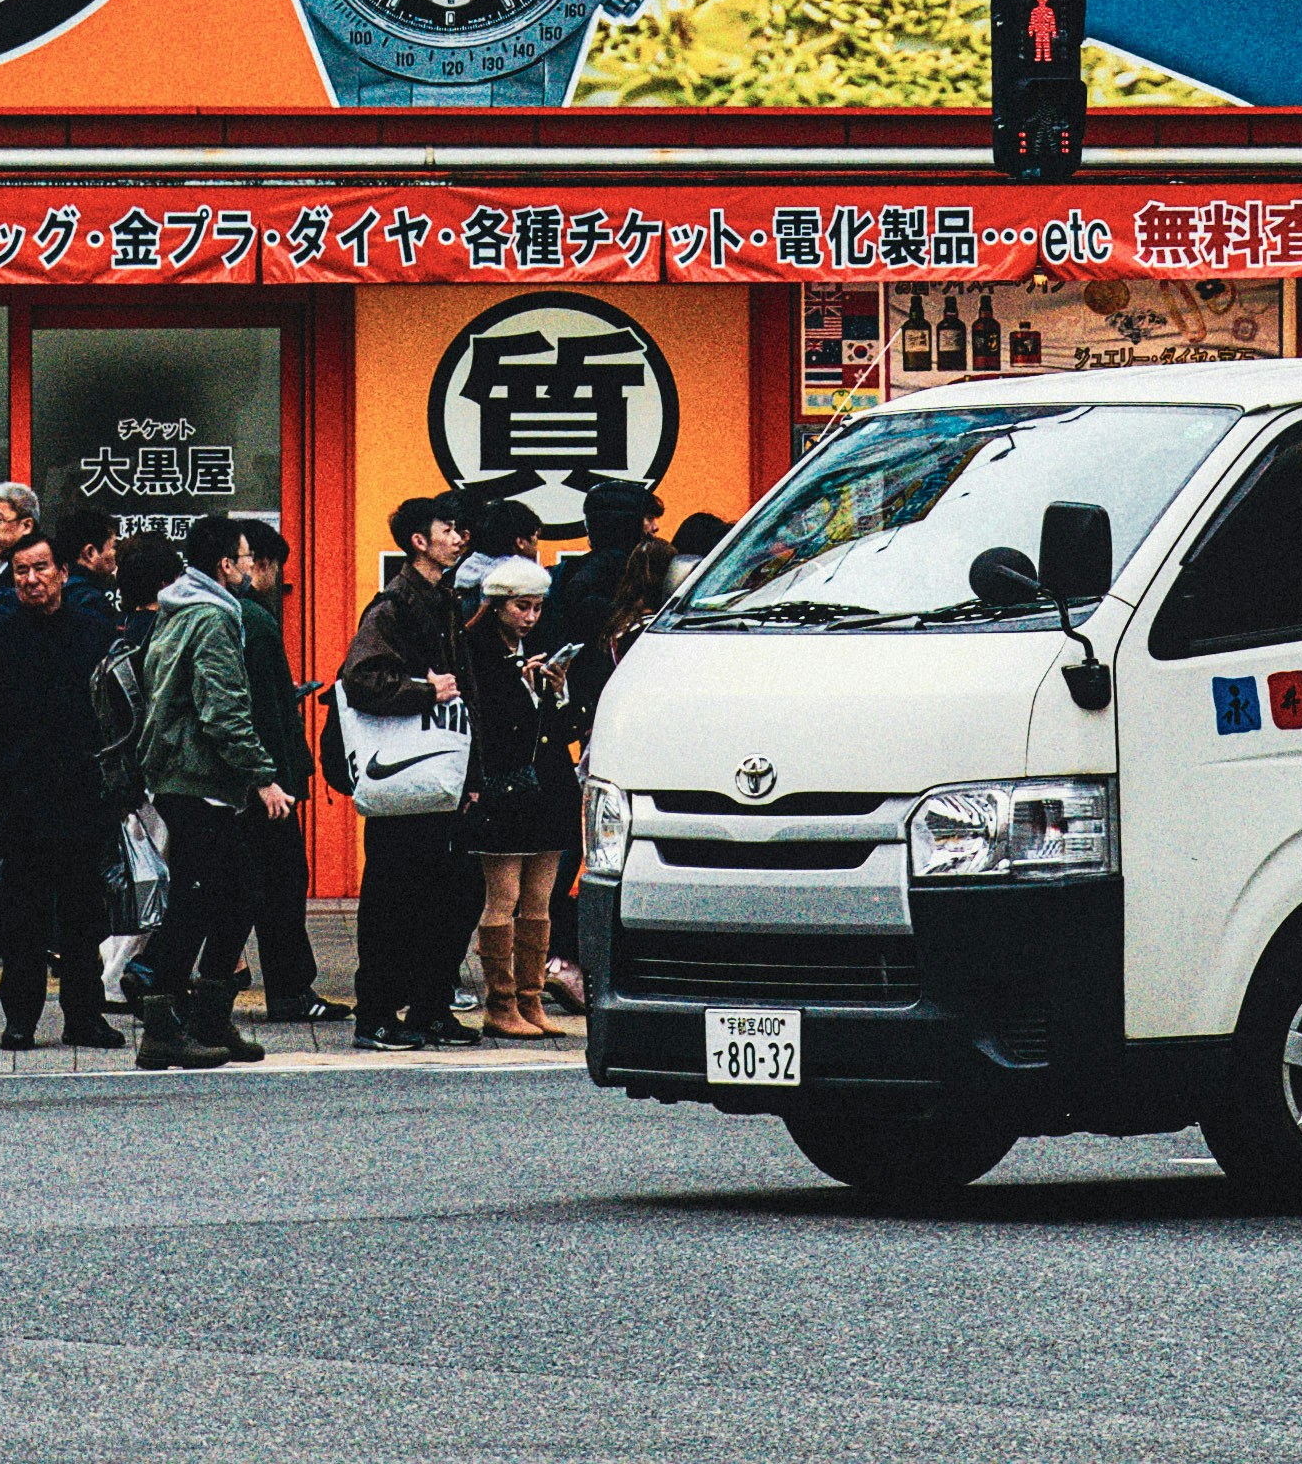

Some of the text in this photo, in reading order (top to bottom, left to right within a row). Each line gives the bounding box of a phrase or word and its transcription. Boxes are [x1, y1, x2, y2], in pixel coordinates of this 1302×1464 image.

[349, 30, 373, 46] 100
[539, 25, 563, 41] 150
[441, 60, 464, 76] 120
[118, 418, 197, 442] チケット
[79, 446, 235, 497] 大黒屋
[728, 1041, 796, 1080] 80-32
